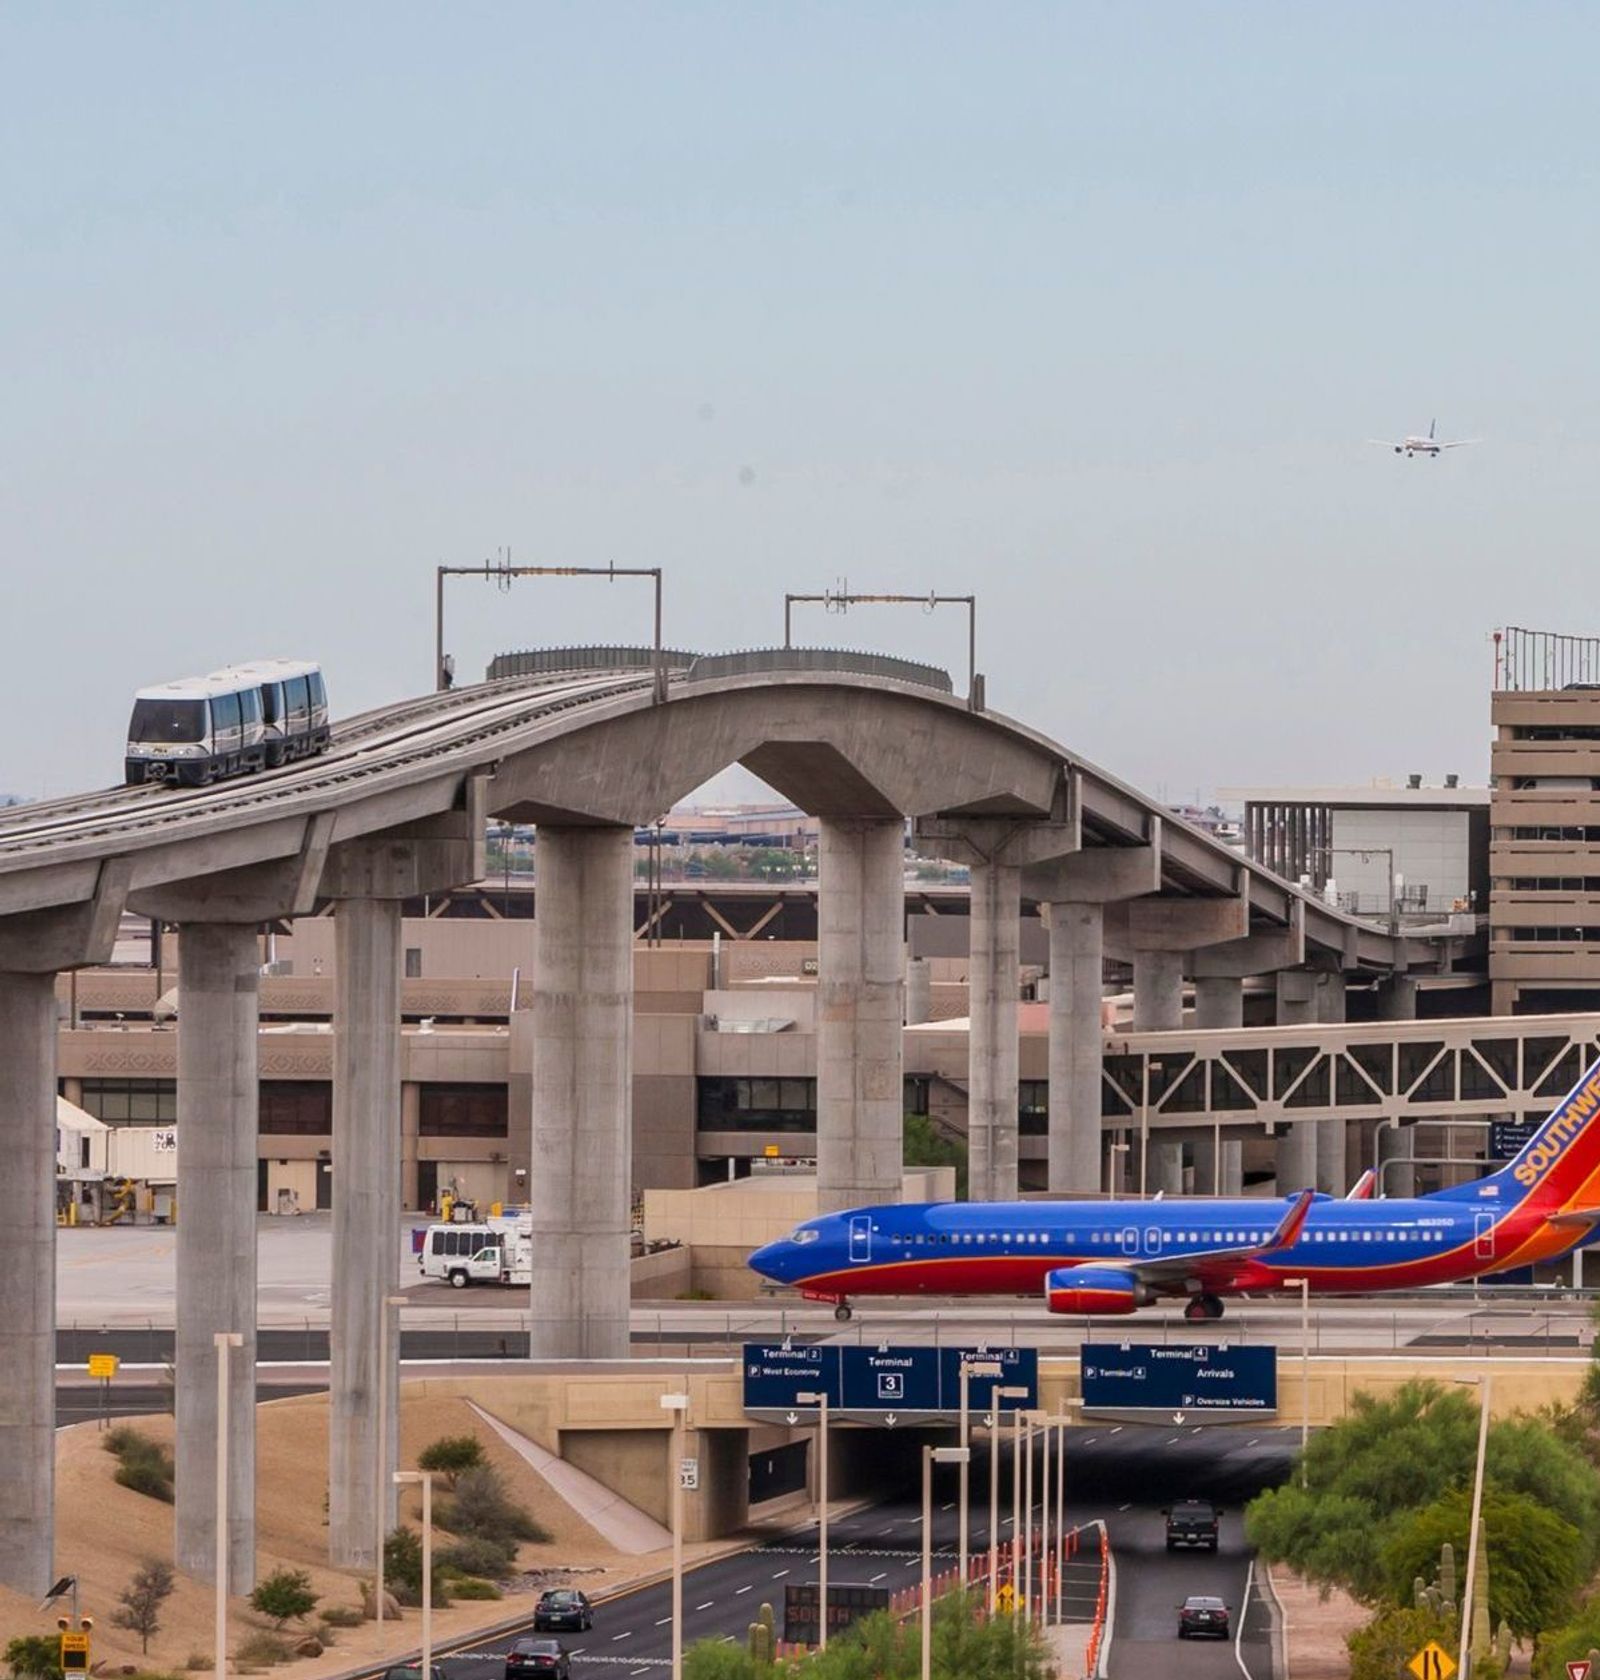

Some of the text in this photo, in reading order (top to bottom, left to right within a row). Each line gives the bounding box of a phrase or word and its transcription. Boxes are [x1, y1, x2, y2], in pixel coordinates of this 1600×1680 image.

[762, 1348, 807, 1359] Terminal
[958, 1351, 1004, 1361] Terminal
[1150, 1348, 1193, 1359] Terminal
[867, 1356, 913, 1367] Terminal
[784, 1368, 820, 1378] Economy
[1099, 1368, 1133, 1378] Terminal
[1196, 1368, 1235, 1379] Arrivals
[885, 1376, 896, 1391] 3
[1196, 1397, 1231, 1406] Oversize
[1231, 1397, 1266, 1406] Vehicles
